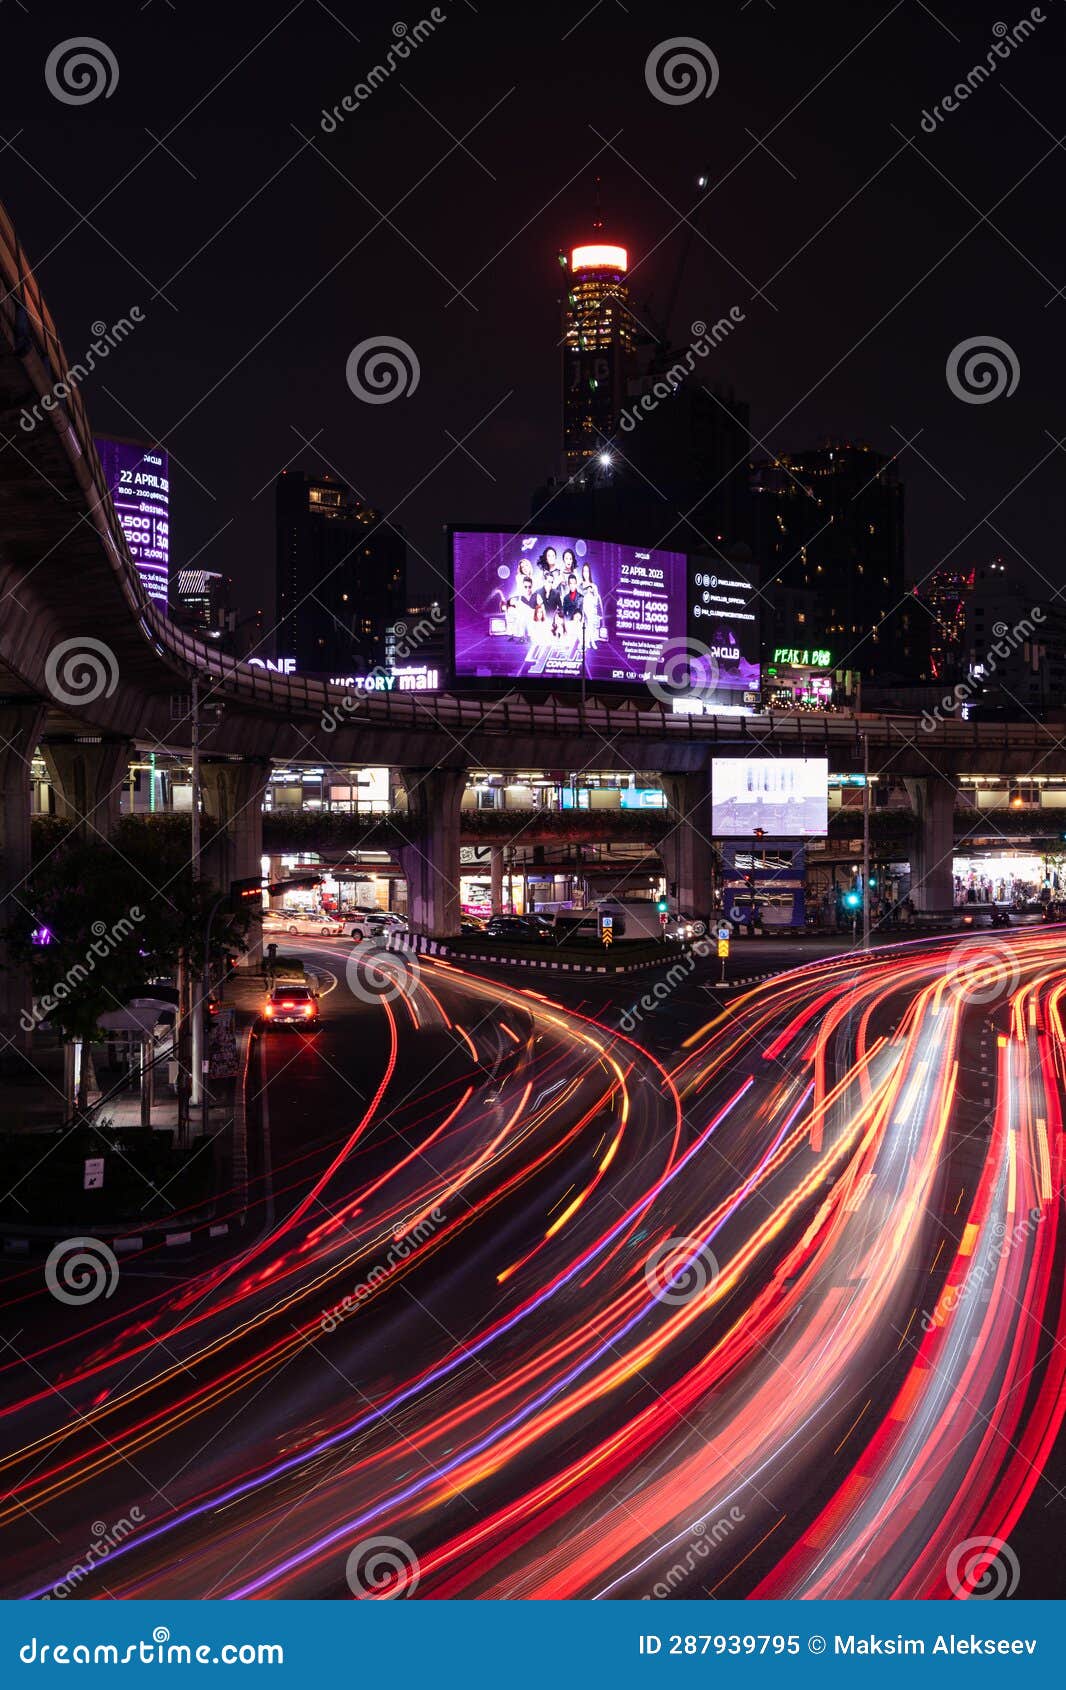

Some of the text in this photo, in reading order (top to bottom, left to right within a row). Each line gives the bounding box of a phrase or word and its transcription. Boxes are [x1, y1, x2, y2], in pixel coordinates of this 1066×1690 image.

[120, 470, 132, 483] 22
[134, 472, 160, 488] APRIL
[621, 564, 664, 579] 22 APRIL 2023
[616, 597, 669, 612] 4,500 4,000
[645, 612, 669, 623] 3,000
[720, 647, 740, 660] CLUB
[774, 649, 800, 663] PEAK
[801, 650, 809, 665] A
[399, 669, 439, 691] mall
